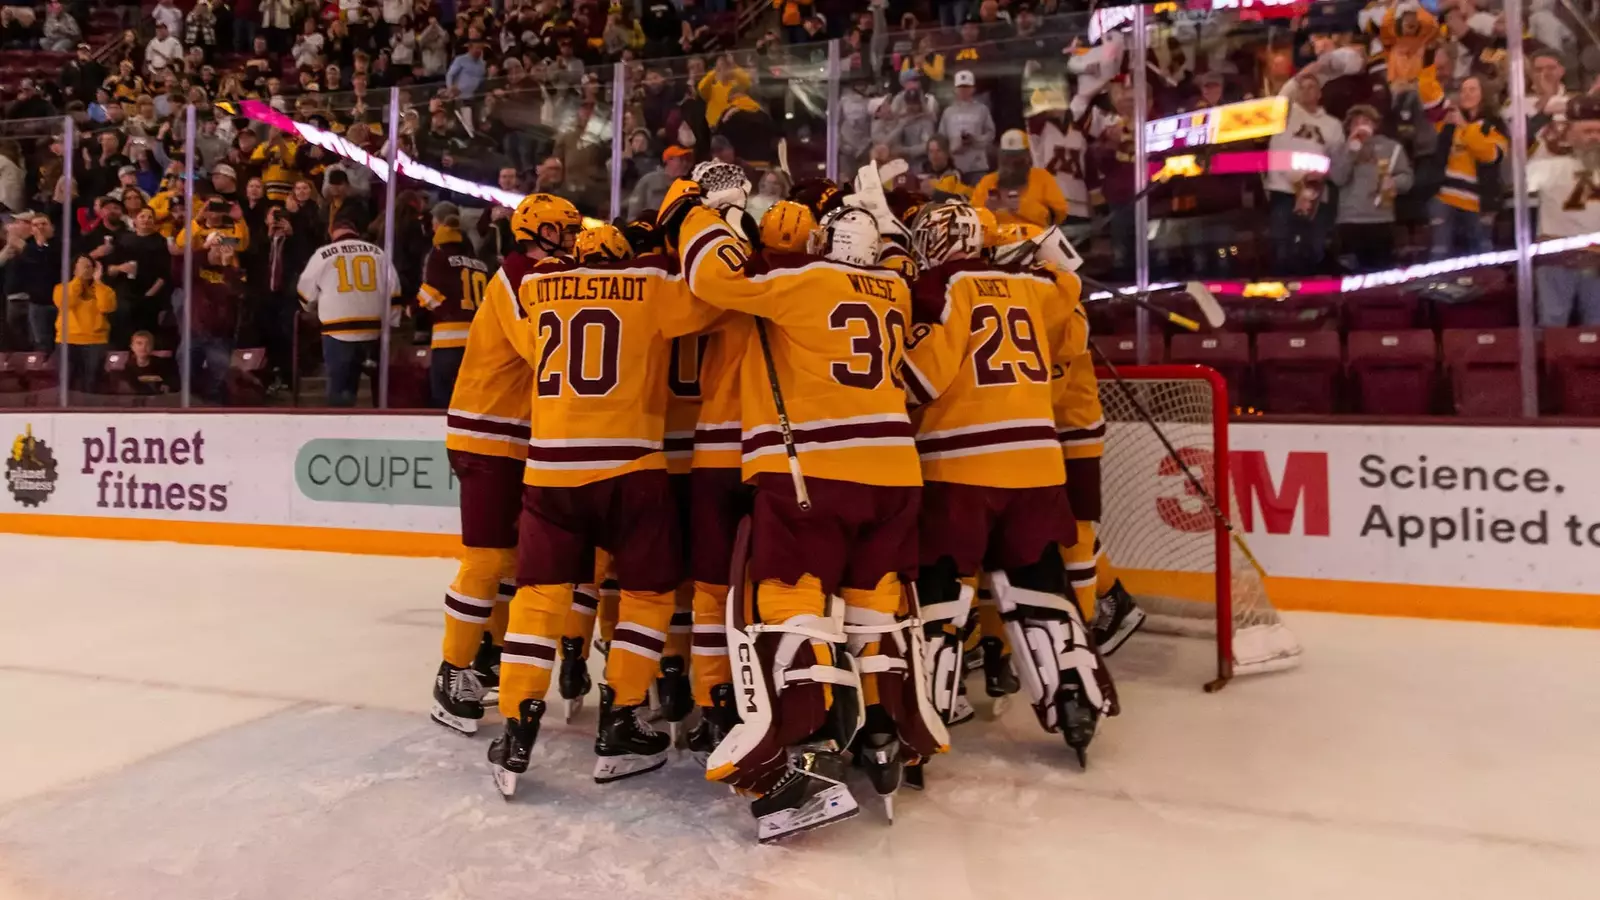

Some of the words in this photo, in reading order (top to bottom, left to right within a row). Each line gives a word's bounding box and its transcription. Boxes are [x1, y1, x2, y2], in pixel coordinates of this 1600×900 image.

[333, 255, 377, 293] 10
[846, 273, 896, 302] WIESE
[537, 307, 623, 398] 20
[828, 301, 904, 391] 30
[970, 303, 1050, 388] 29
[82, 427, 205, 474] planet
[308, 454, 433, 489] COUPE
[97, 471, 228, 512] fitness
[1156, 447, 1330, 537] 3M
[1359, 454, 1565, 494] Science.
[1360, 505, 1548, 548] Applied
[738, 643, 757, 713] CCM
